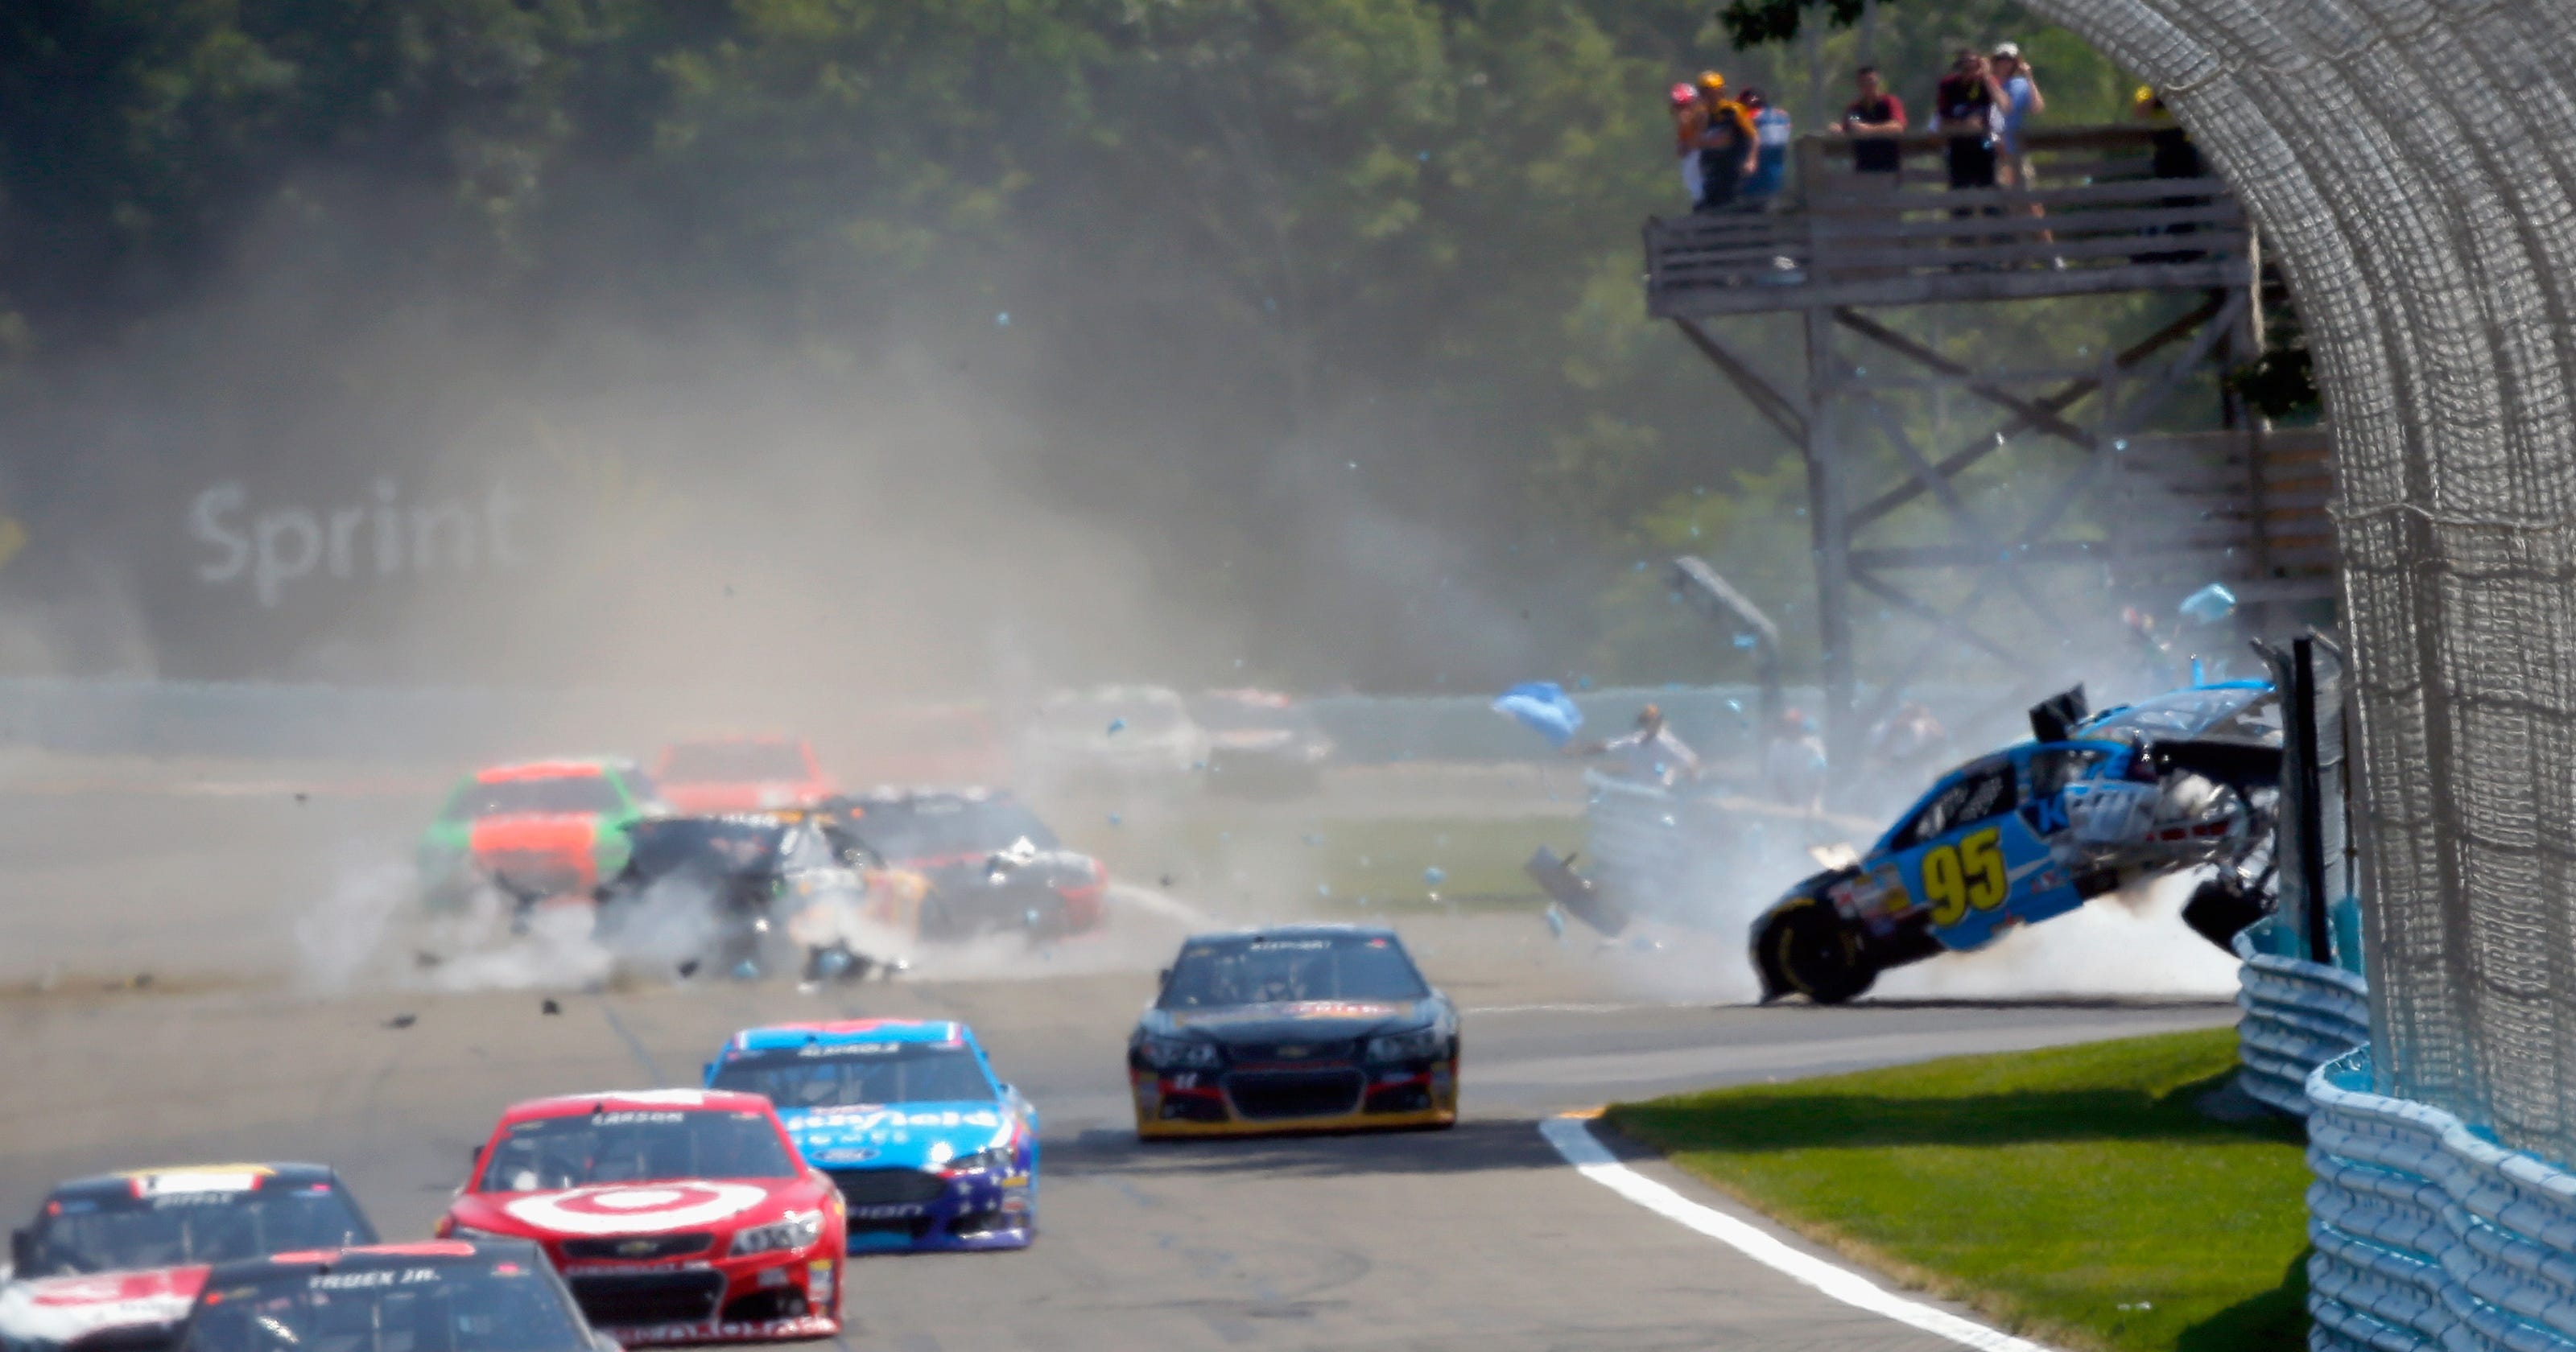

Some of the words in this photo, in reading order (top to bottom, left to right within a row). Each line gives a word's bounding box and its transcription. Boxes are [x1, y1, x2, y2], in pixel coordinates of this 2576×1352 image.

[187, 478, 525, 608] Sprint
[1922, 826, 2007, 927] 95
[590, 1111, 684, 1127] LARSON
[308, 1270, 395, 1288] TRUEX
[399, 1267, 441, 1284] JR.
